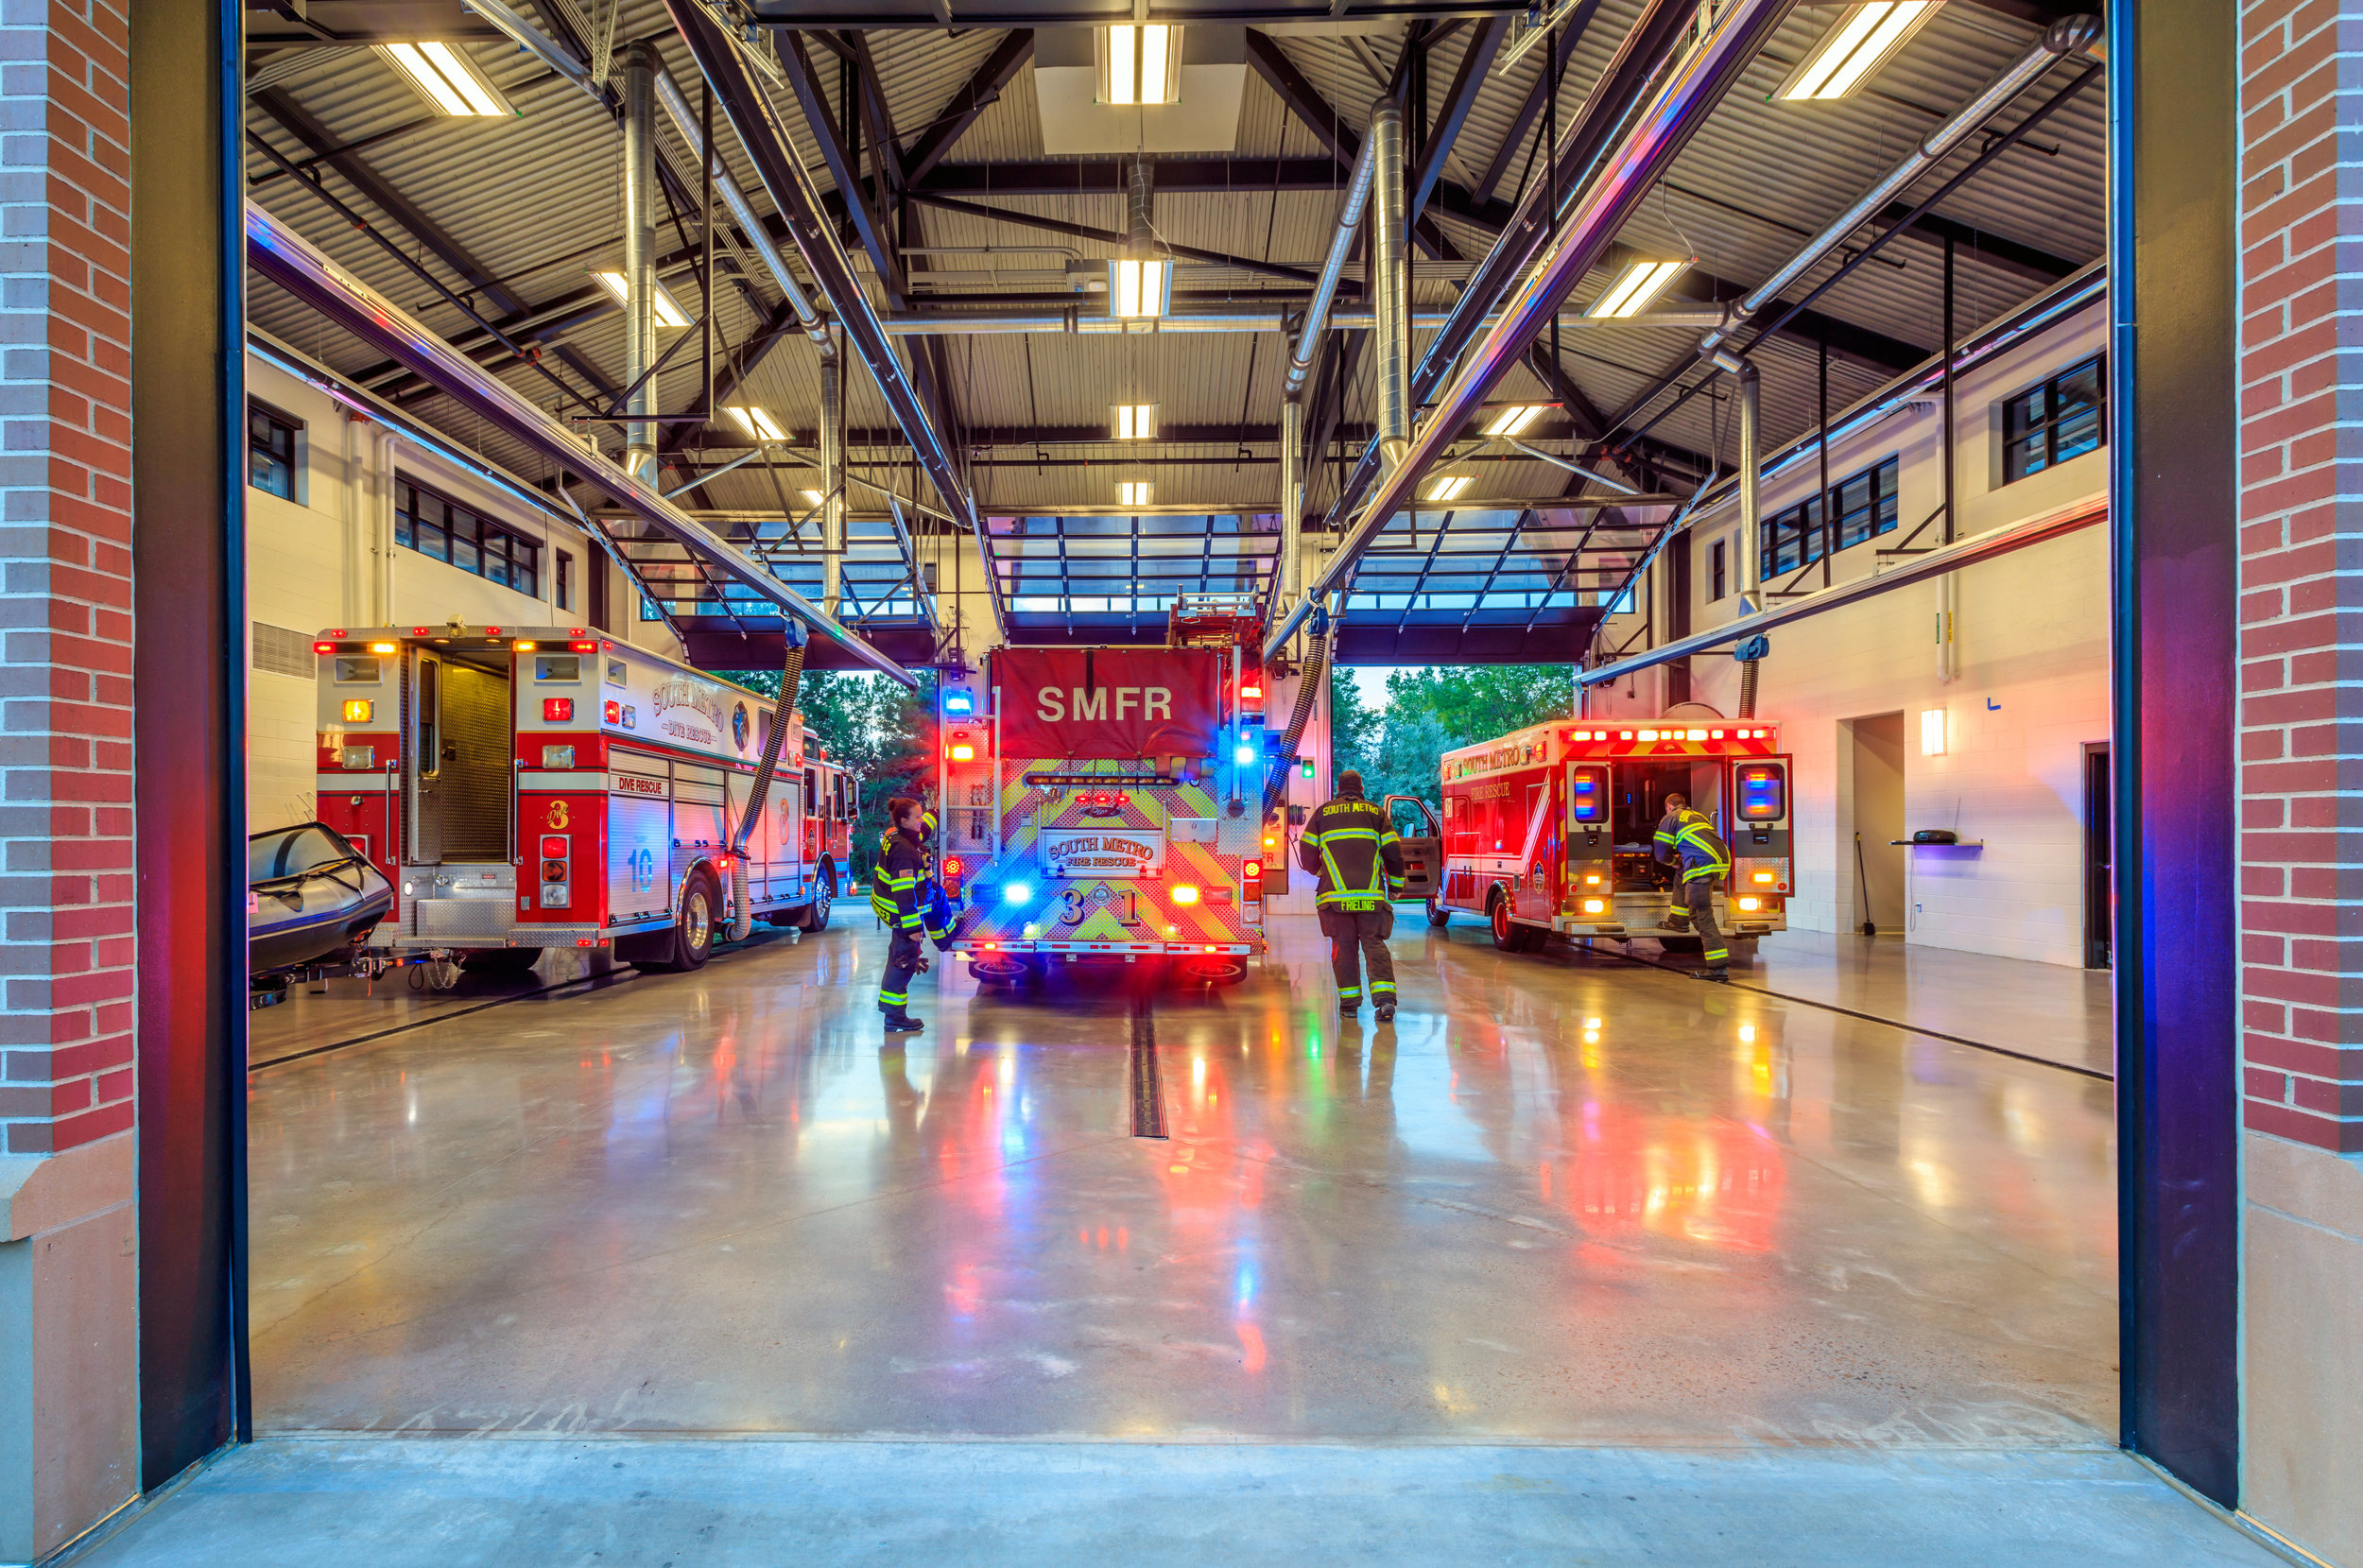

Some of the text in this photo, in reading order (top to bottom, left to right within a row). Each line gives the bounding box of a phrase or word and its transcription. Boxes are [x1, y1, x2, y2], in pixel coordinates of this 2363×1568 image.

[652, 681, 724, 732] SOUTH METRO
[1037, 686, 1172, 722] SMFR
[668, 720, 712, 745] DIVE RESCUE
[1462, 745, 1520, 776] SOUTH METRO
[619, 777, 662, 794] DIVE RESCUE
[1471, 782, 1510, 801] FIRE RESCUE
[1323, 802, 1379, 817] SOUTH METRO
[1048, 836, 1153, 861] SOUTH METRO
[628, 849, 653, 893] 10
[1066, 857, 1136, 867] FIRE RESCUE
[1341, 901, 1375, 911] FRIELING
